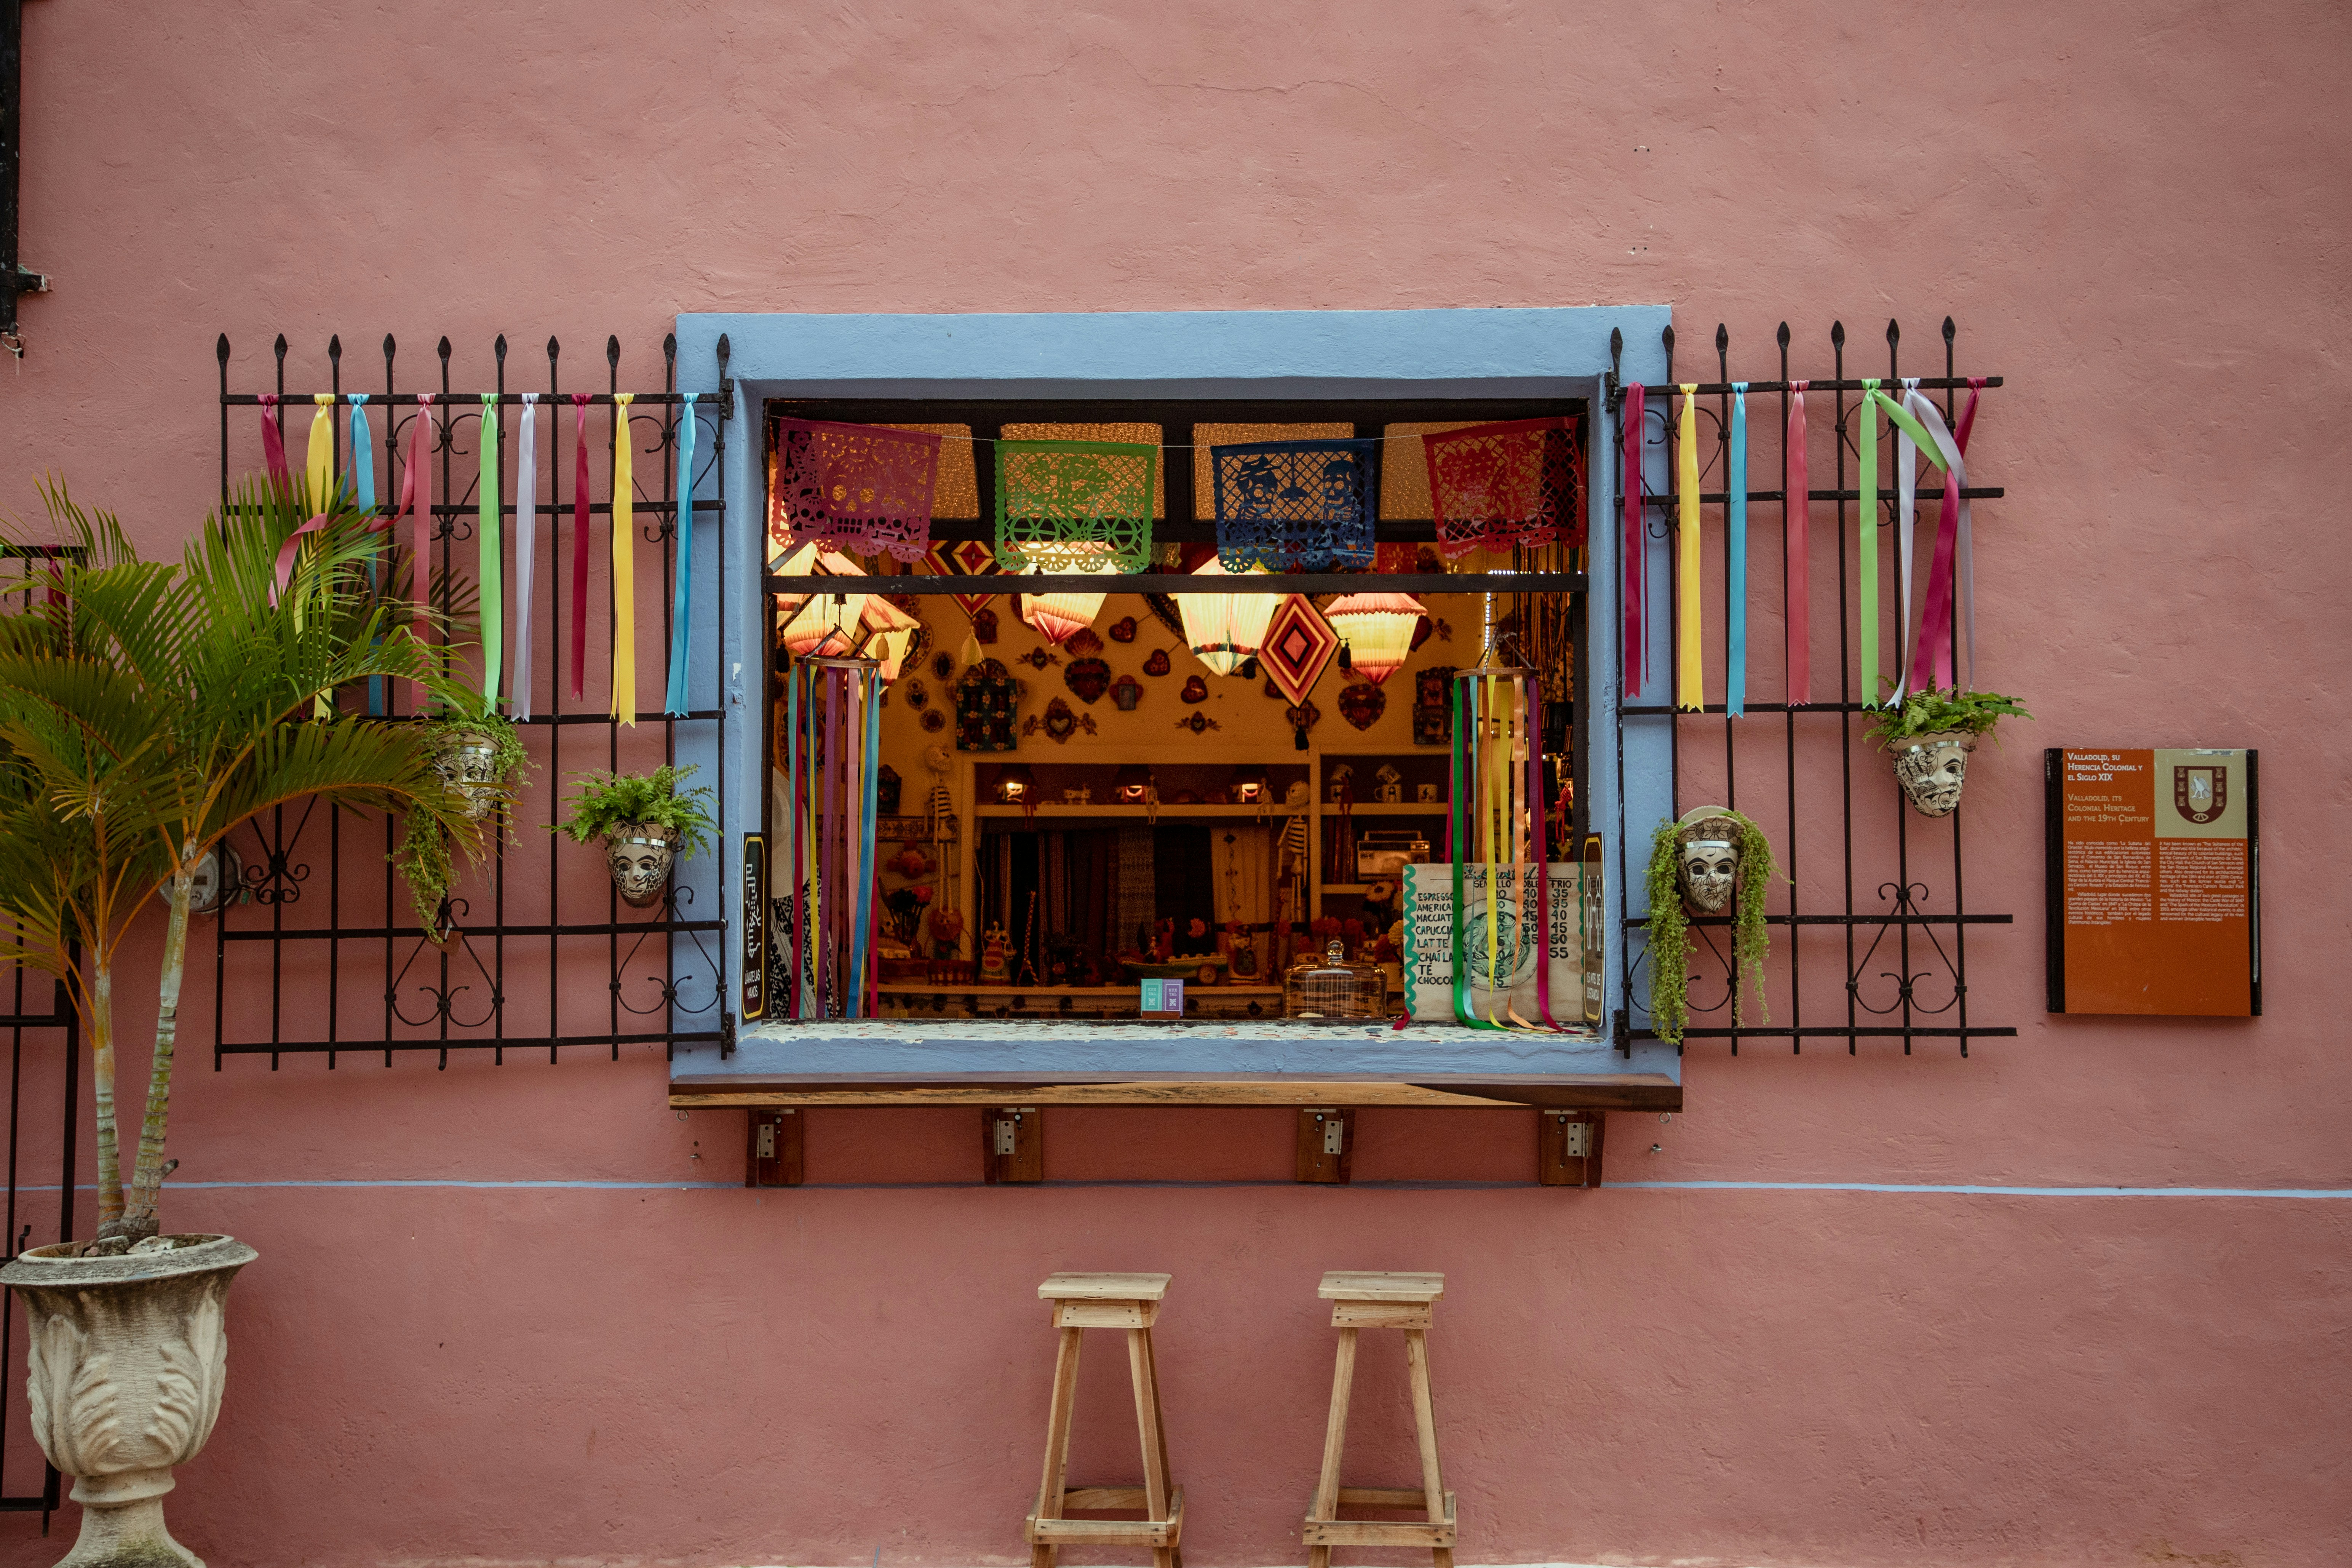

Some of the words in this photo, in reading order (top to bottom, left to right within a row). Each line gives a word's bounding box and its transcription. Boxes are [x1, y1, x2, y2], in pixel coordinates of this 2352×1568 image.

[1523, 889, 1537, 898] 40
[1552, 888, 1568, 898] 35
[1417, 903, 1465, 912] AMERICA
[1523, 899, 1538, 908] 40
[1552, 899, 1568, 909] 35
[1416, 913, 1453, 922] MACCIAT
[1522, 911, 1538, 921] 45
[1551, 909, 1567, 921] 40
[1416, 926, 1453, 935] CAPUCCI
[1522, 923, 1538, 932] 50
[1551, 922, 1567, 933] 45
[1417, 938, 1449, 948] LATTE
[1550, 933, 1567, 944] 50
[1549, 947, 1568, 959] 55
[1418, 962, 1433, 975] TÉ
[1597, 973, 1600, 985] DE
[747, 985, 758, 999] MANOS
